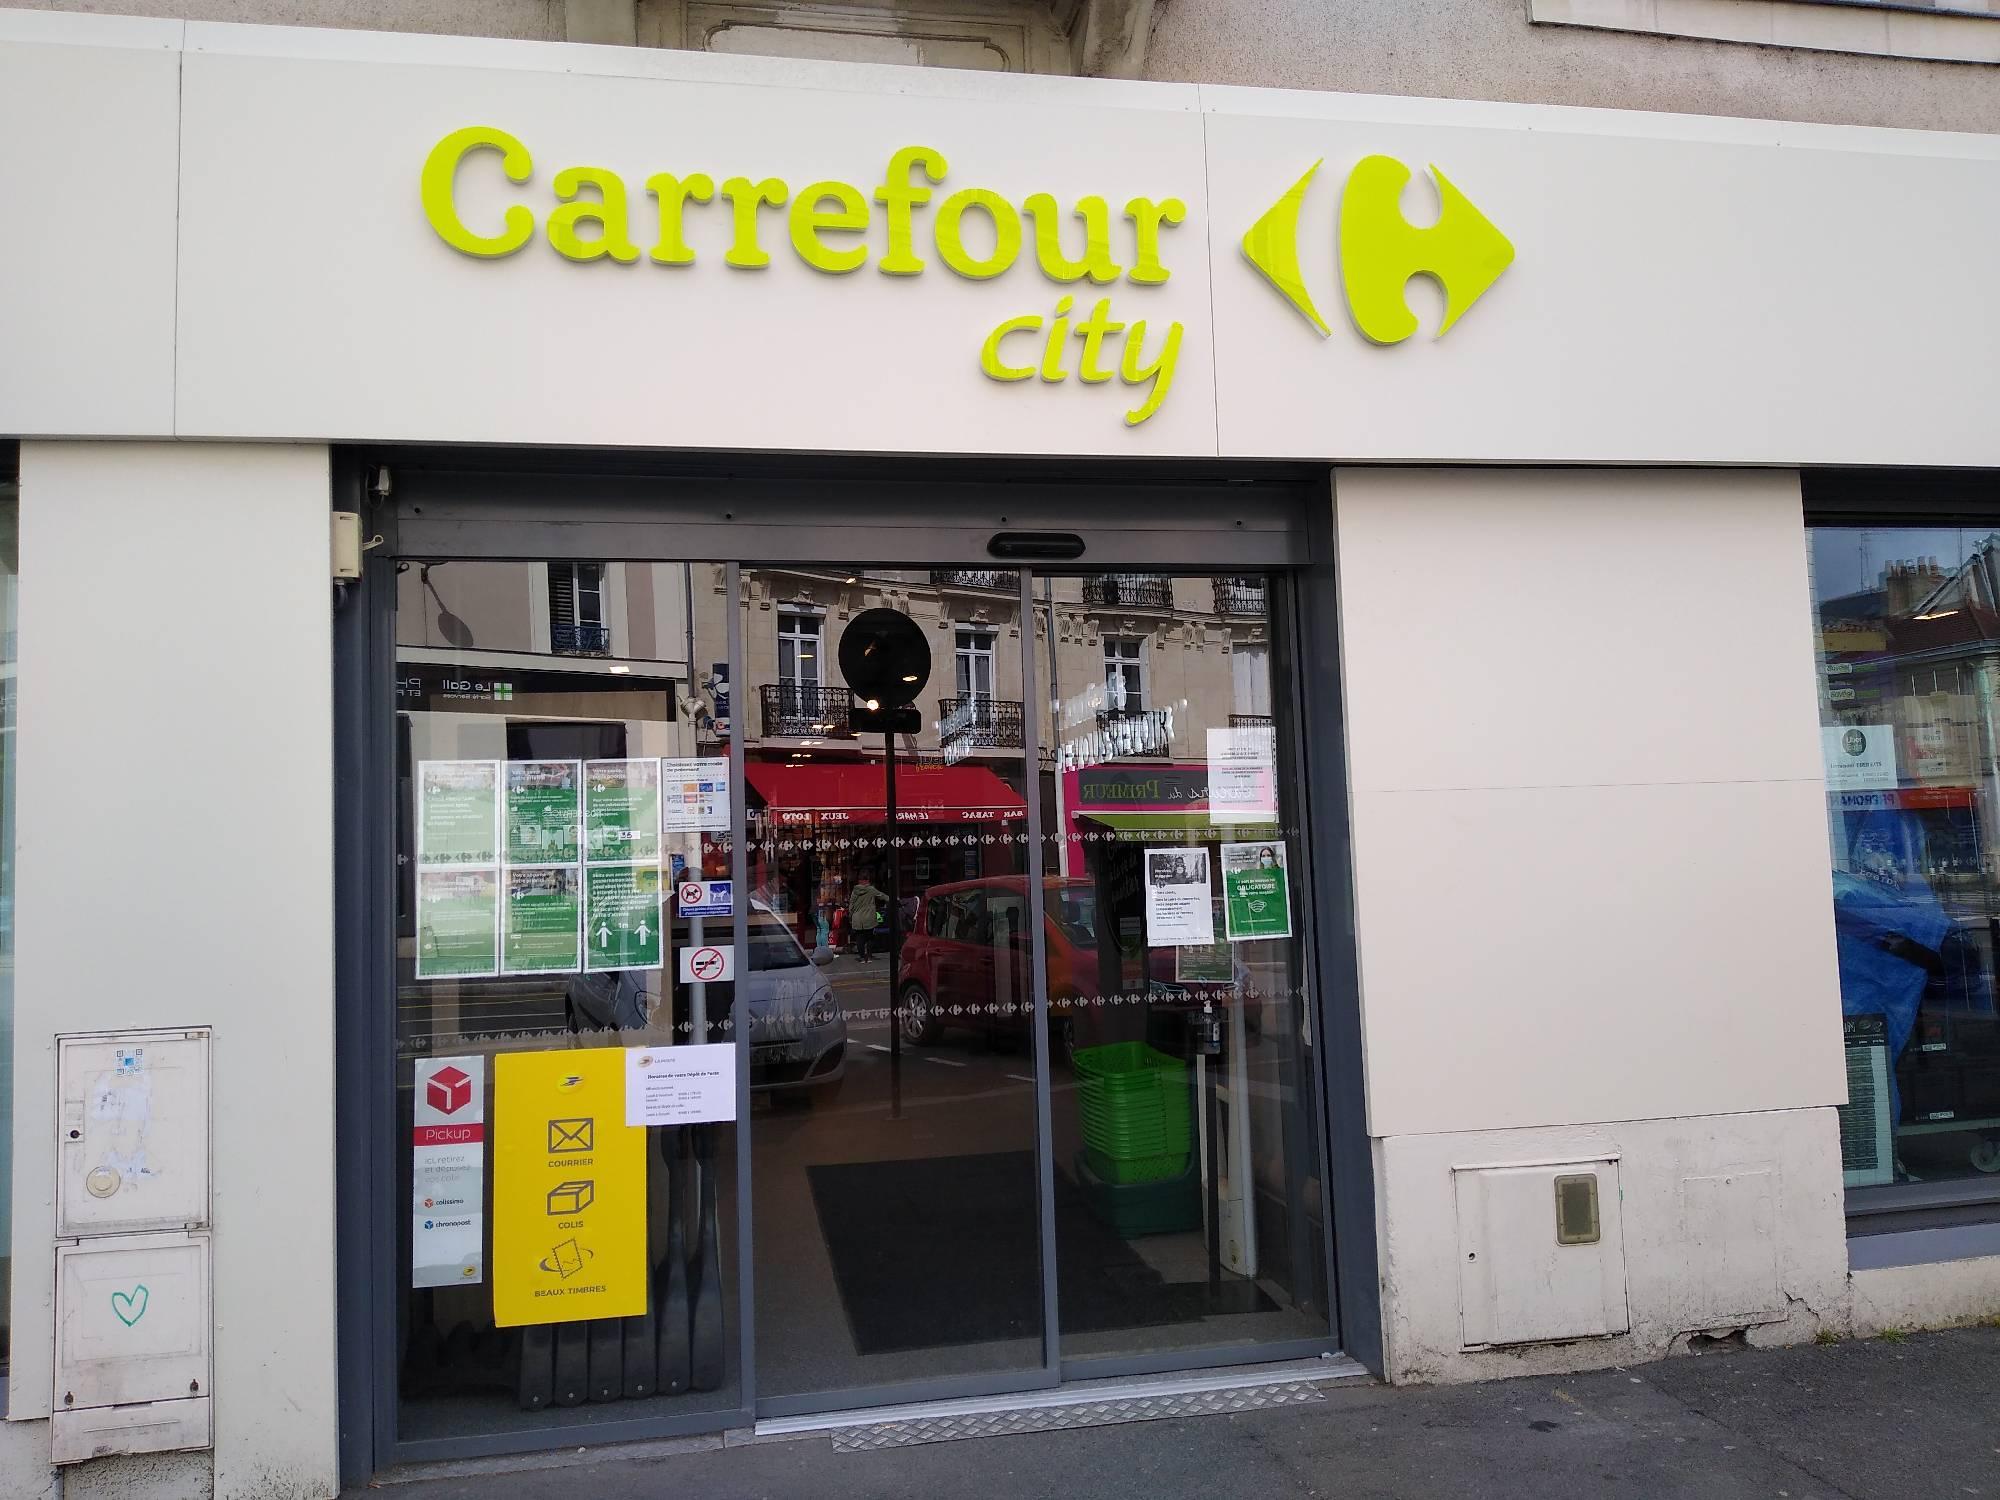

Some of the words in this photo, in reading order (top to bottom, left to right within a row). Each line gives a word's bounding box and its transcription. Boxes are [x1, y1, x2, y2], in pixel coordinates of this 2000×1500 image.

[421, 126, 1186, 286] Carrefour
[980, 295, 1184, 427] city
[425, 1128, 472, 1141] Pickup
[437, 1156, 465, 1164] retirez
[548, 1158, 594, 1168] COURRIER
[436, 1198, 464, 1206] colissimo
[436, 1219, 472, 1229] chronopost
[558, 1220, 584, 1230] COLIS
[534, 1288, 565, 1298] BEAUX
[568, 1284, 607, 1295] TIMBRES
